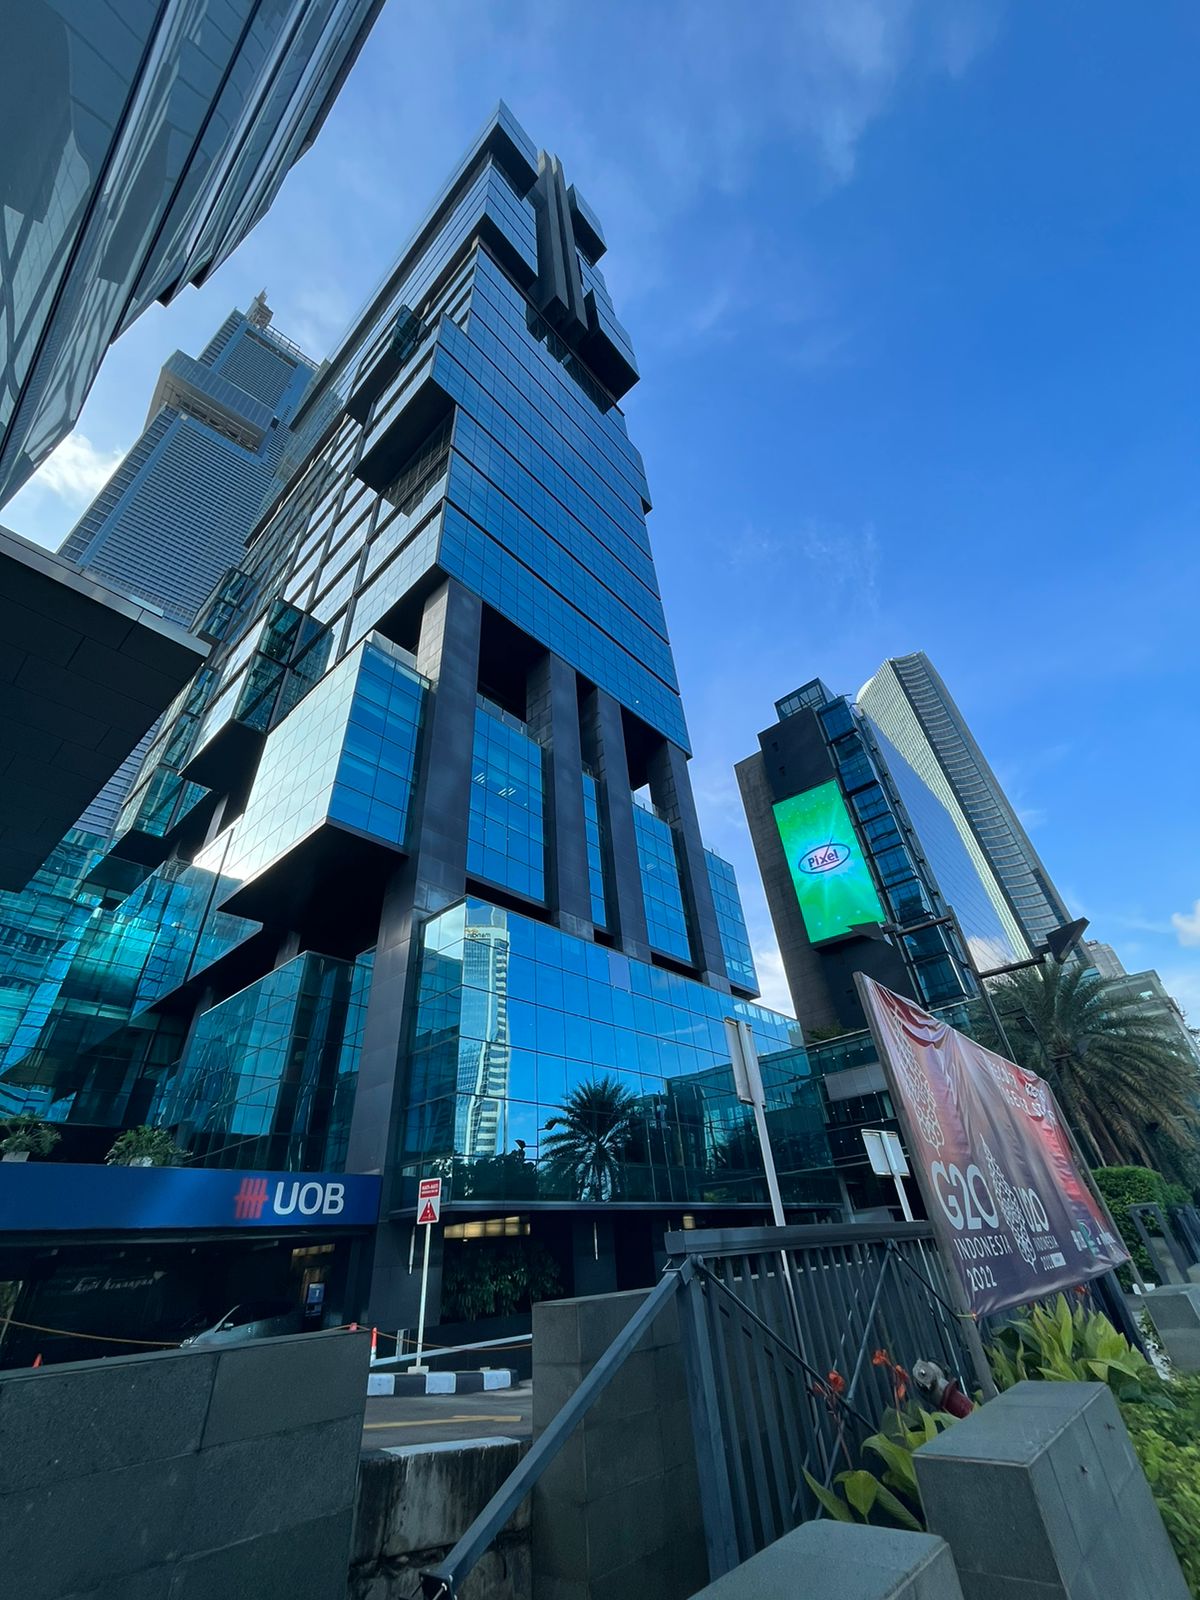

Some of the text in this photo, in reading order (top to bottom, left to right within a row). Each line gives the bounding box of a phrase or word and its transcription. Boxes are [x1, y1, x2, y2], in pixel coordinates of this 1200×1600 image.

[273, 1181, 345, 1216] UOB
[931, 1160, 999, 1230] G20
[1012, 1186, 1050, 1232] U20
[955, 1235, 1013, 1260] INDONESIA
[966, 1265, 997, 1292] 2022
